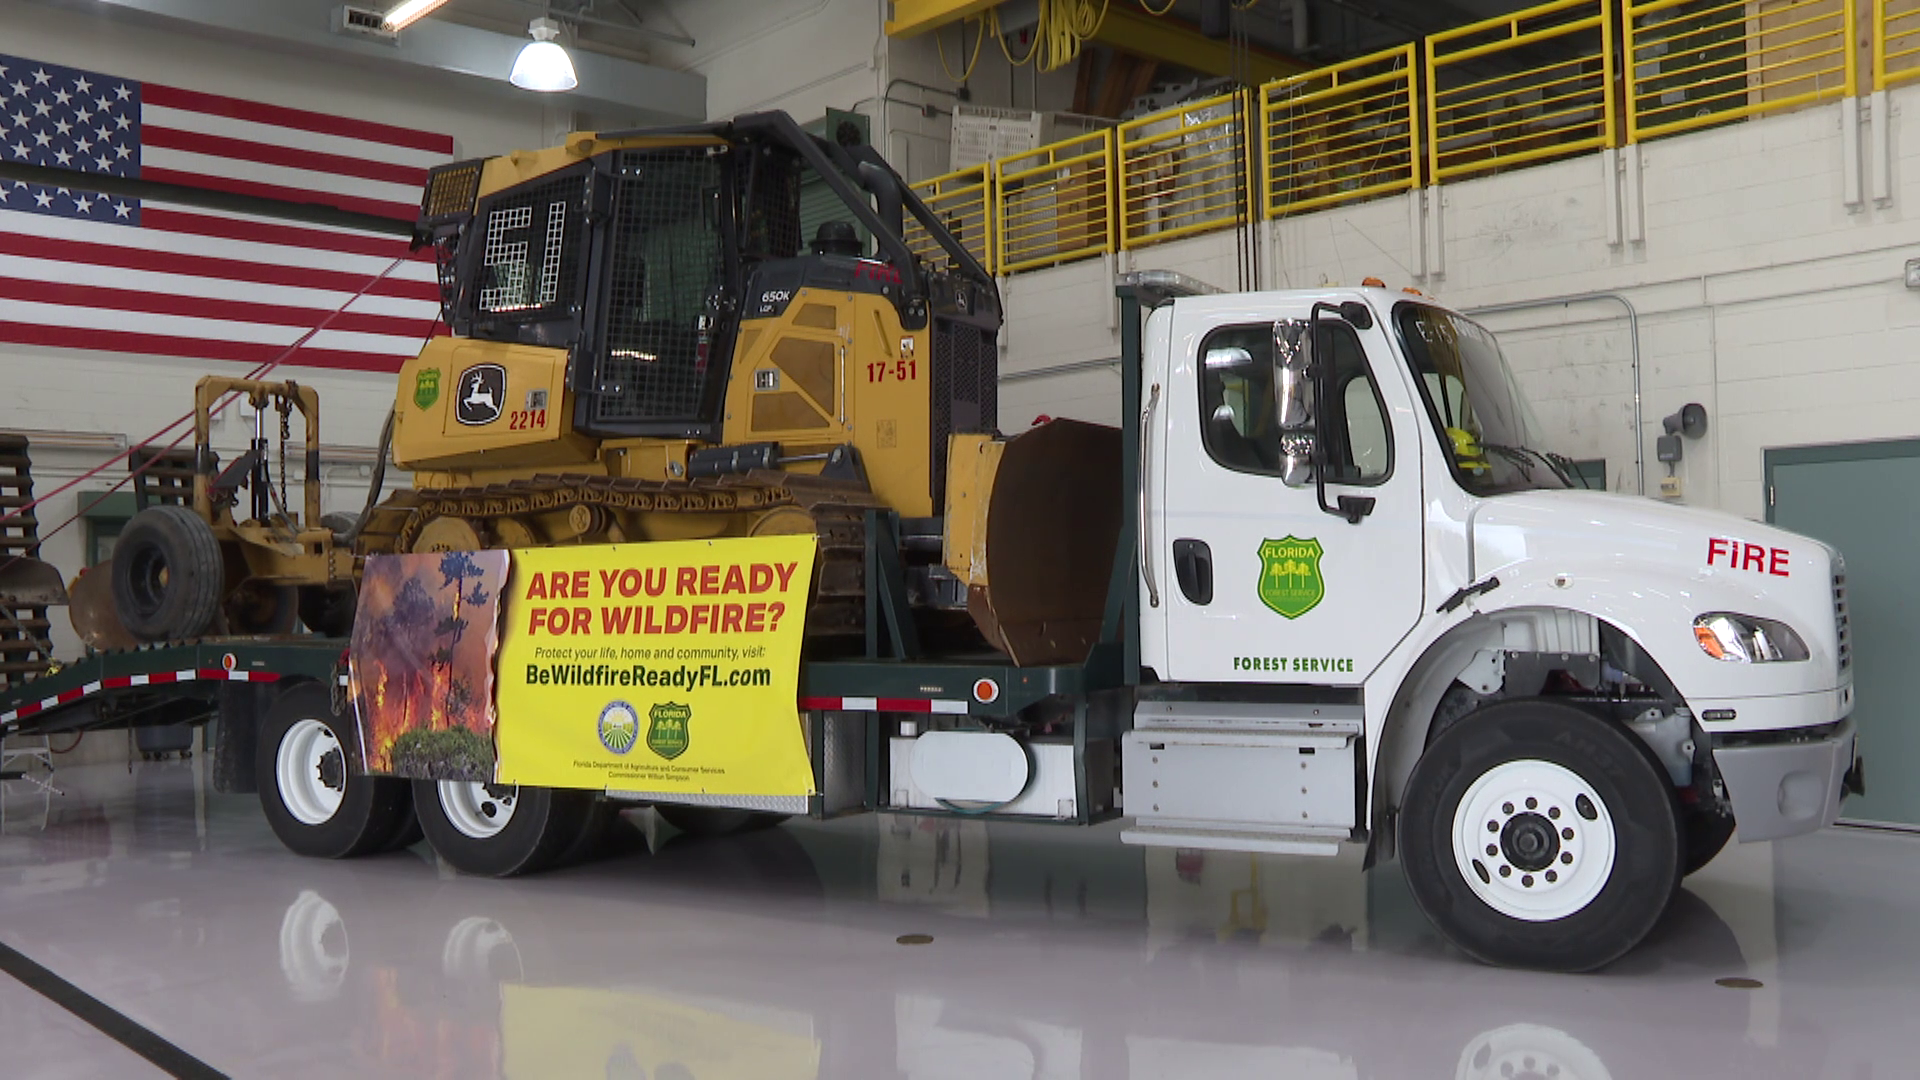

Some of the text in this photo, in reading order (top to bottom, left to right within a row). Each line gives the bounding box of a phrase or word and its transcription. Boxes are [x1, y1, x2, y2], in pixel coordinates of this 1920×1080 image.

[761, 291, 790, 302] 650K
[867, 360, 916, 383] 17-51
[510, 409, 546, 430] 2214
[1265, 547, 1315, 558] FLORIDA
[526, 562, 798, 600] ARE YOU READY
[528, 602, 785, 635] FOR WILDFIRE?
[535, 645, 766, 661] Protect your life, home and community, visit:
[1233, 657, 1353, 672] FOREST SERVICE
[526, 664, 771, 692] BeWildfireReadyFL.com
[654, 710, 686, 718] FLORIDA
